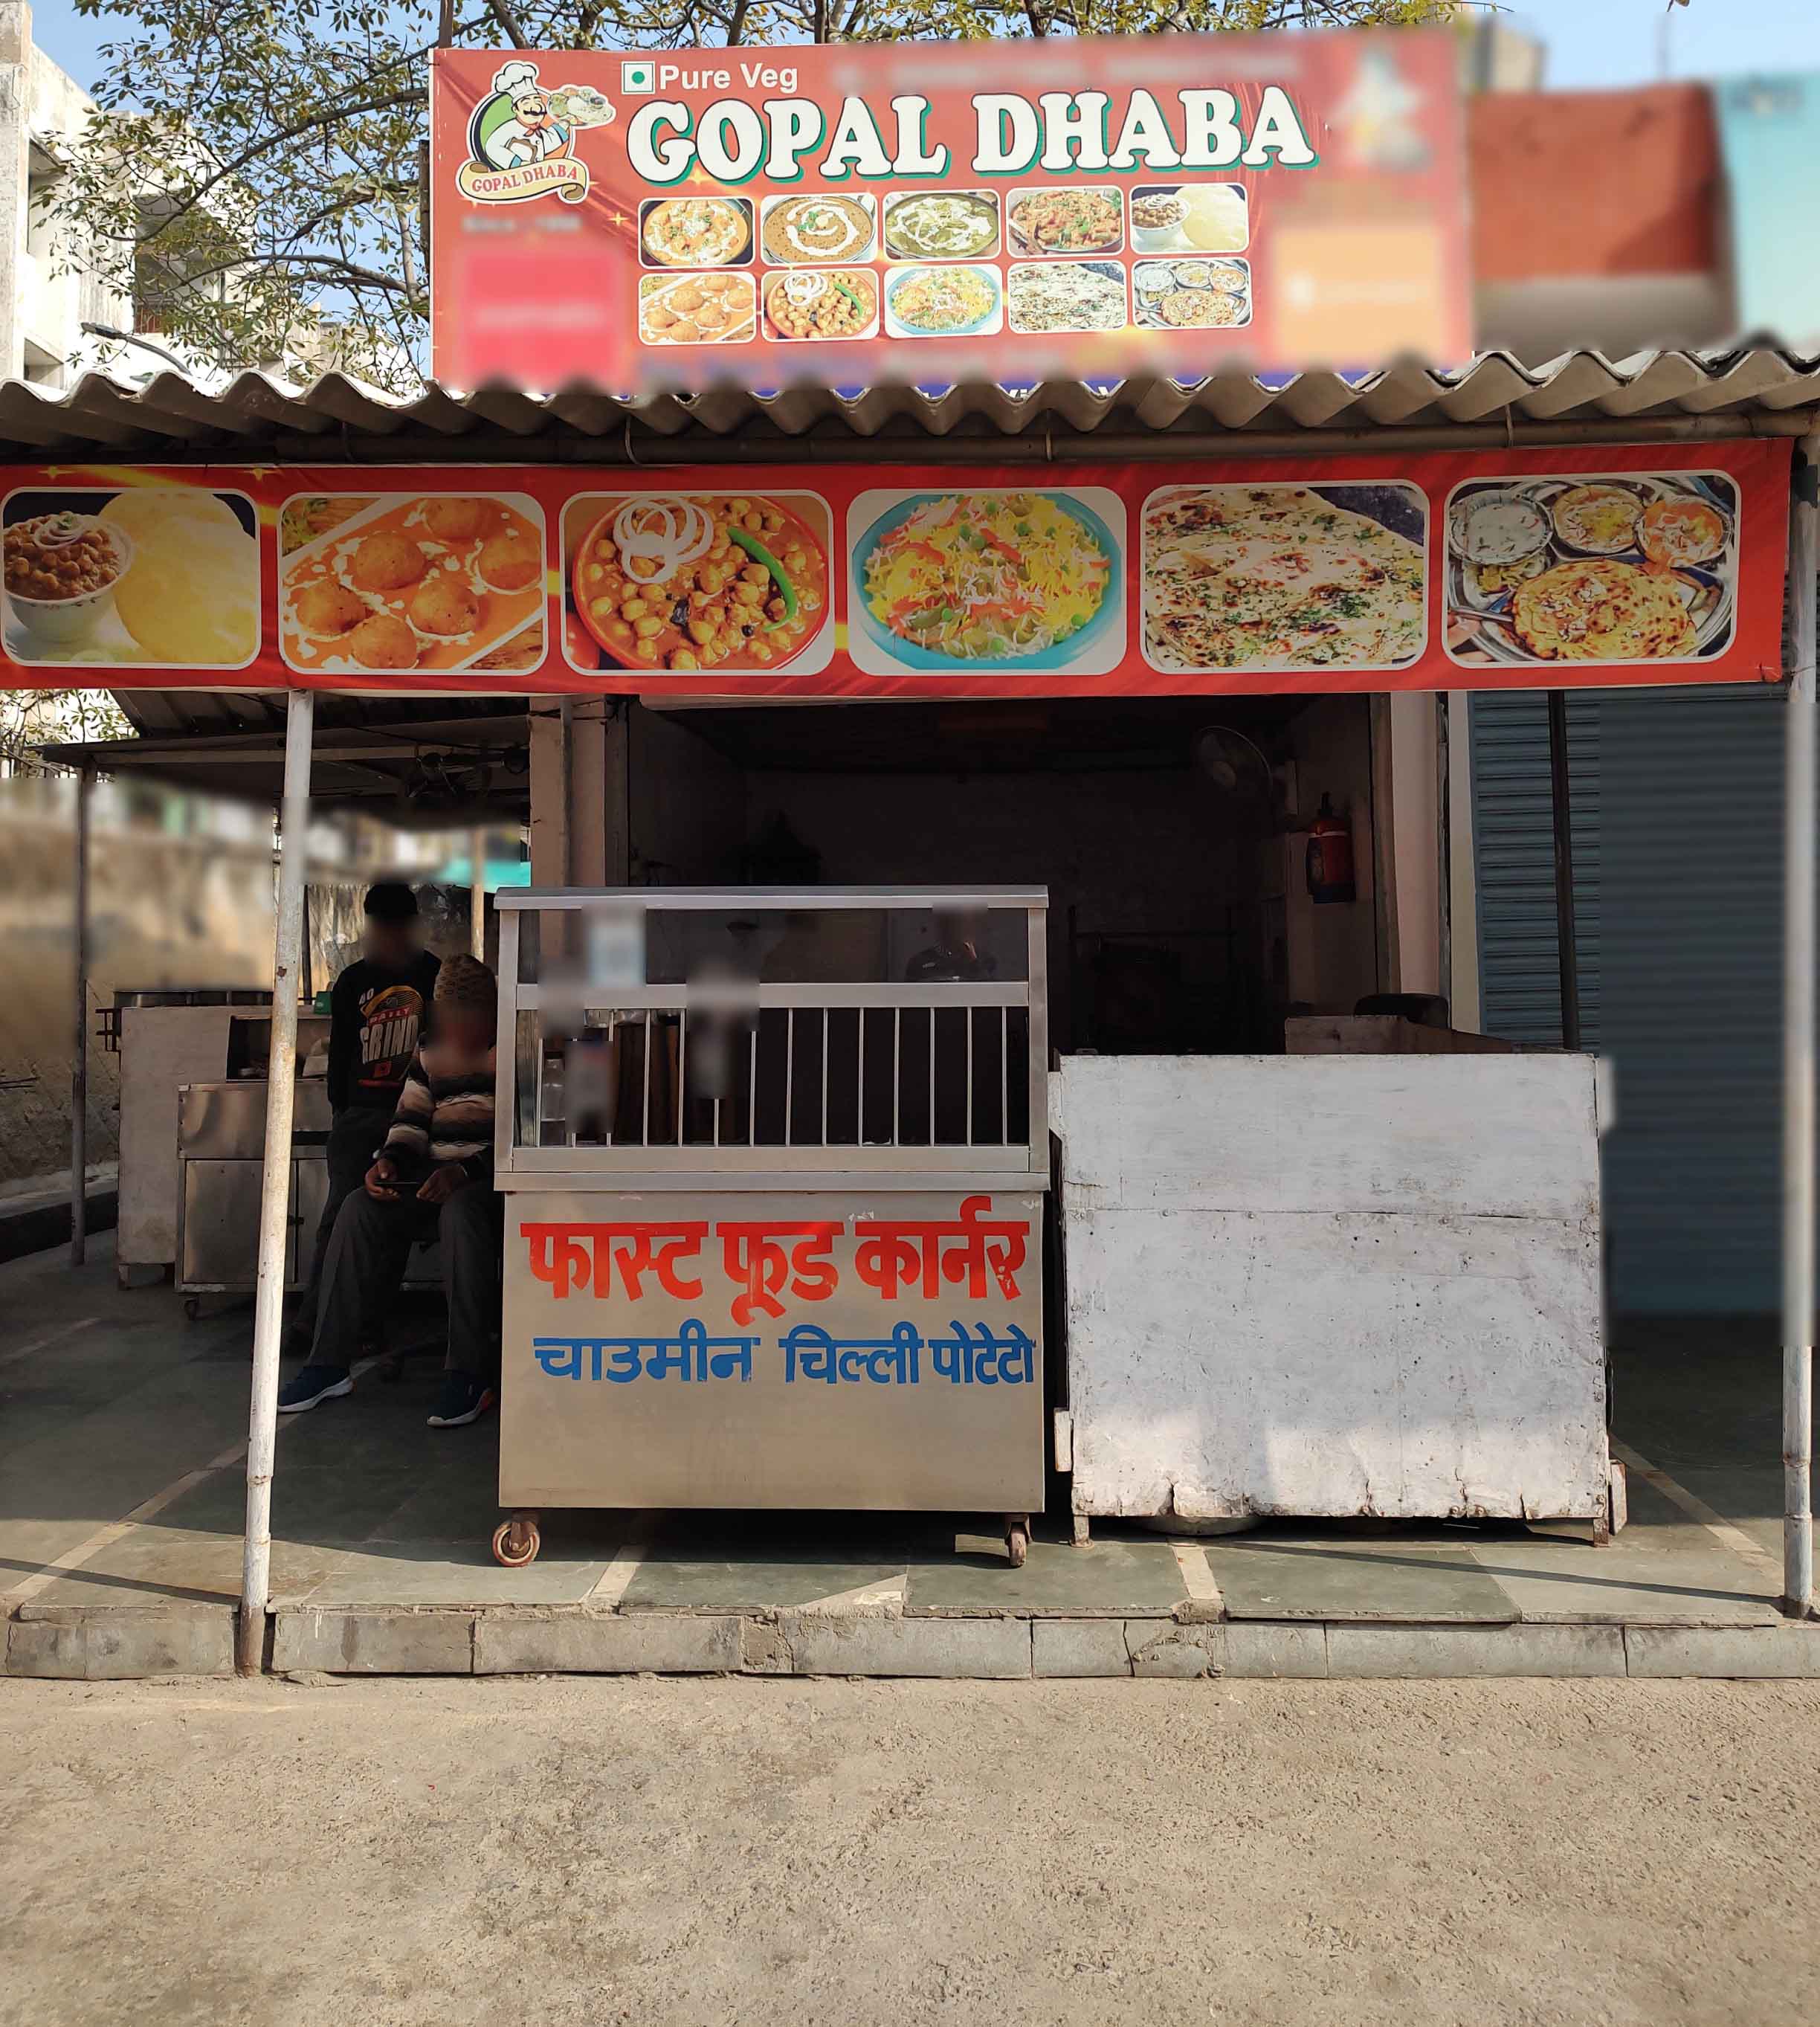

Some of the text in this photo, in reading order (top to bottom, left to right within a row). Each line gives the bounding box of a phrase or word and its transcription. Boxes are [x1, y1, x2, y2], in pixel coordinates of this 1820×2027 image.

[659, 62, 798, 92] Pure Veg
[627, 86, 1319, 184] GOPAL DHABA
[472, 165, 577, 192] GOPAL DHABA
[360, 1015, 418, 1065] GRIND
[520, 1196, 1030, 1327] फास्ट फूड कार्नर
[533, 1318, 1035, 1385] चाउमीन चिल्ली पोटेटो
